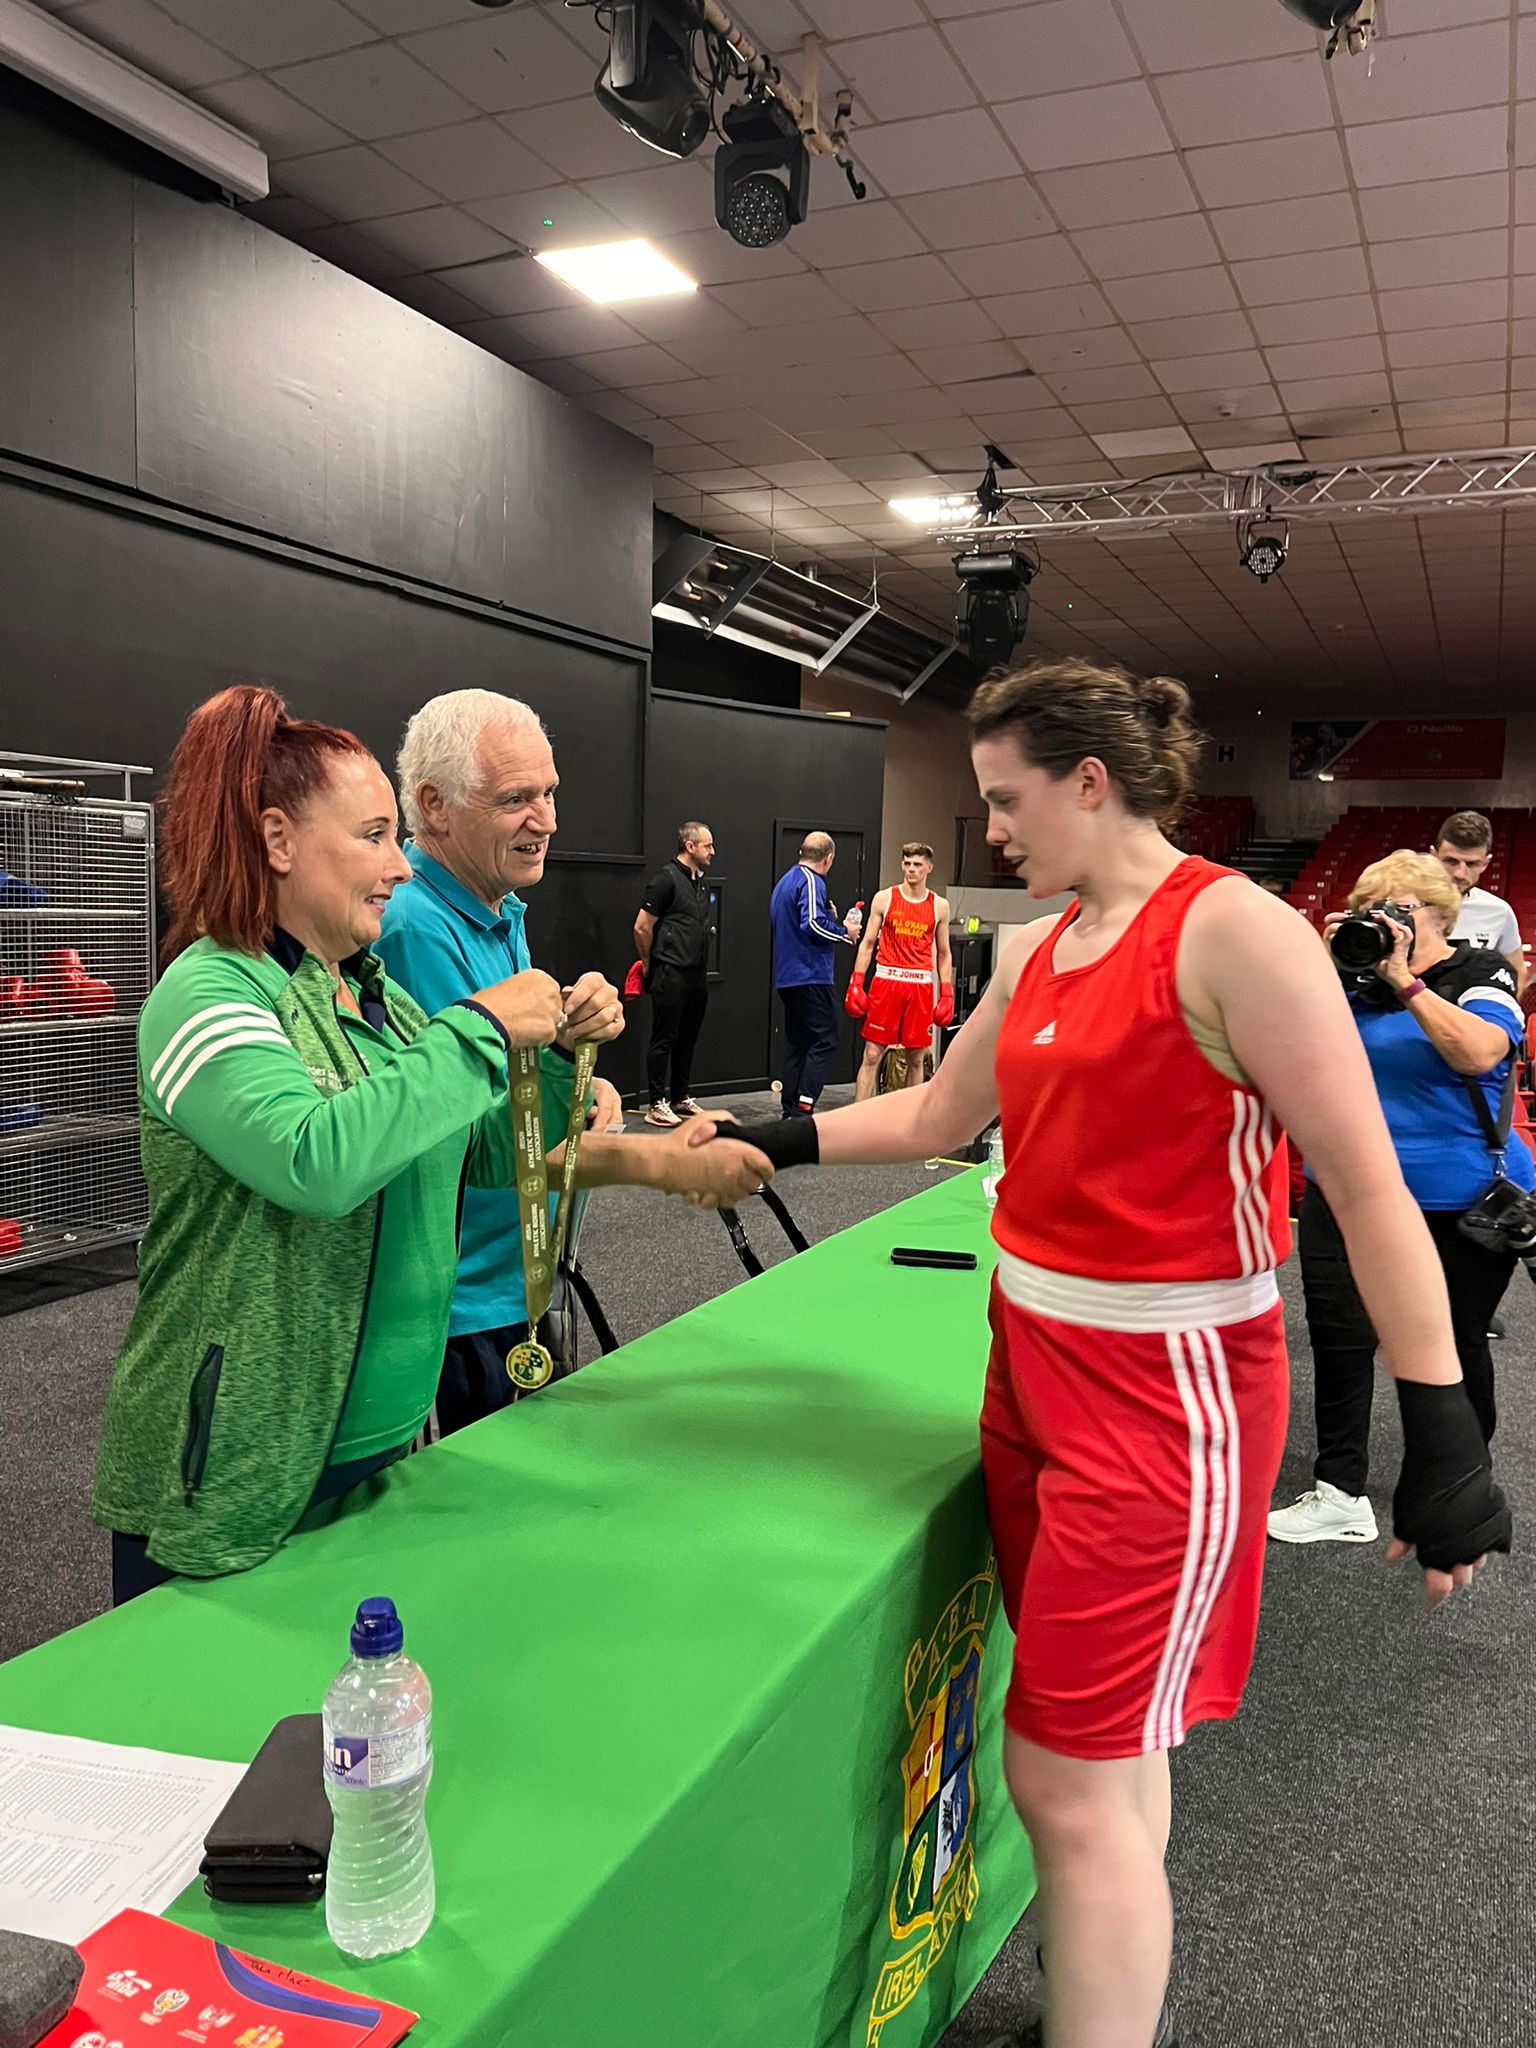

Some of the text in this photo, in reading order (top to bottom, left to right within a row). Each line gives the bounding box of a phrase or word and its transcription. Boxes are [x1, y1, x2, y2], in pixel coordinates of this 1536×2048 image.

[1219, 744, 1234, 762] H
[900, 971, 924, 980] JOHNS
[881, 1871, 967, 2011] IRELAND
